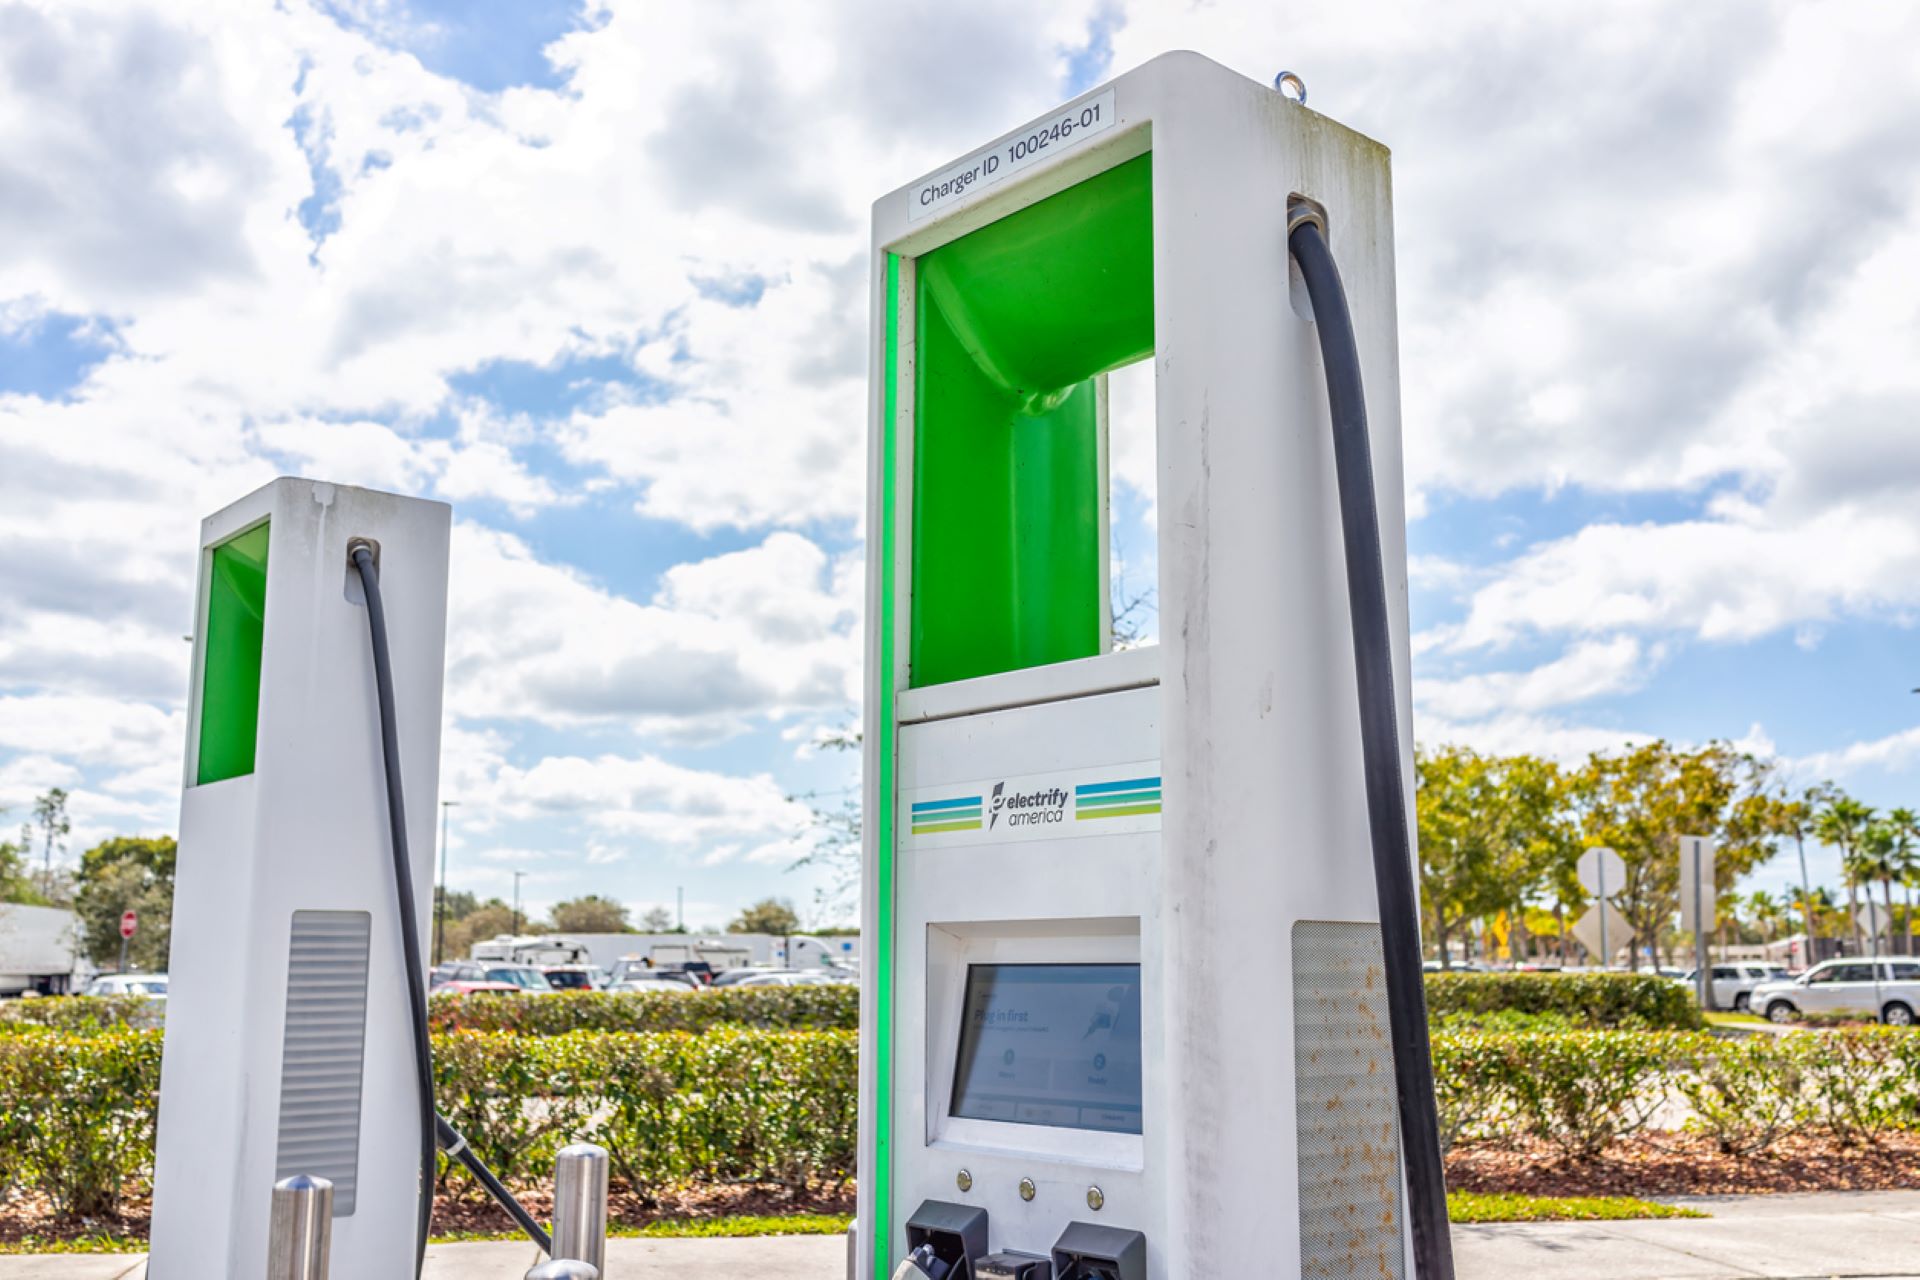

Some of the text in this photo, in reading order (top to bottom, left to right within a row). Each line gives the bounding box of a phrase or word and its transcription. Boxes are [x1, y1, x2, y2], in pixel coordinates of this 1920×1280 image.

[920, 103, 1101, 206] Charger ID 100246-01
[1006, 787, 1069, 809] electrify
[1008, 807, 1064, 827] america
[1007, 1008, 1029, 1022] first
